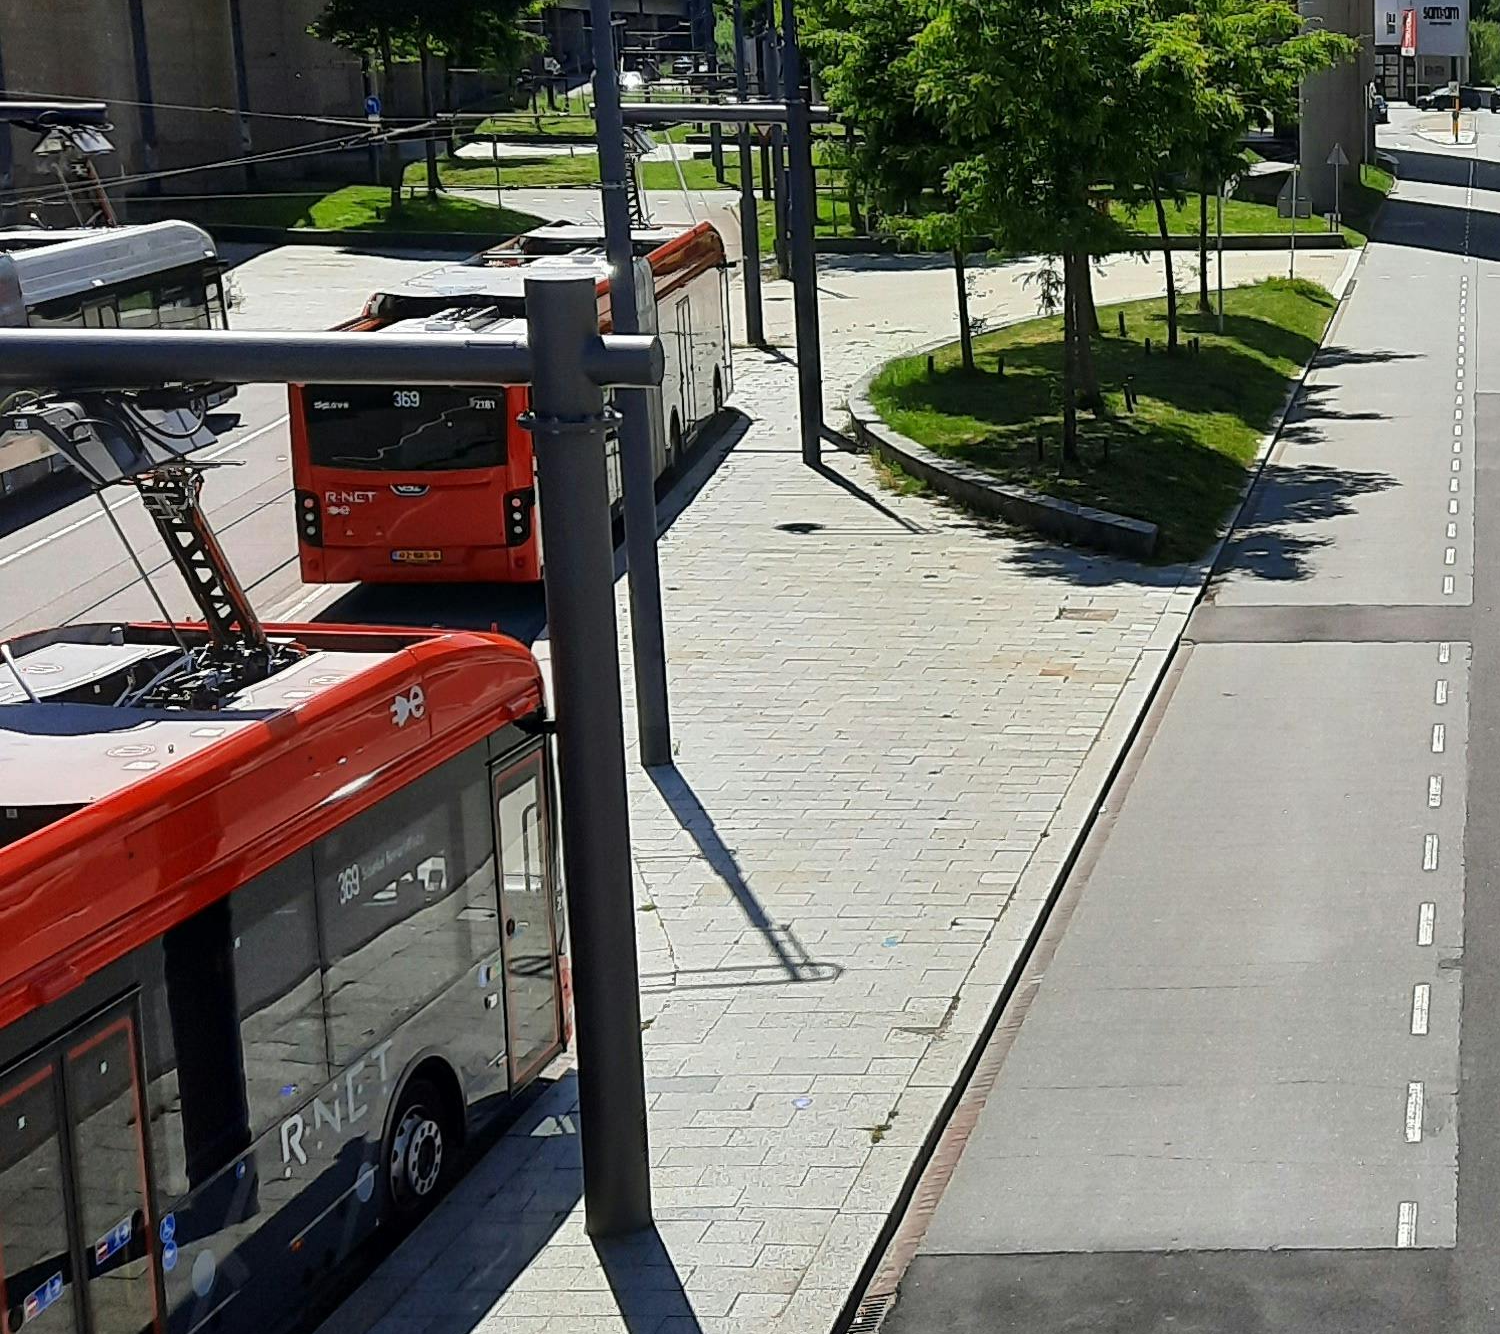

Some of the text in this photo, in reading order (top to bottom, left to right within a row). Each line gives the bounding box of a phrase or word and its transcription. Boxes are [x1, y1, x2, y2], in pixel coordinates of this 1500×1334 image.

[393, 391, 420, 408] 369
[325, 491, 377, 503] R-NET
[338, 863, 360, 904] 369
